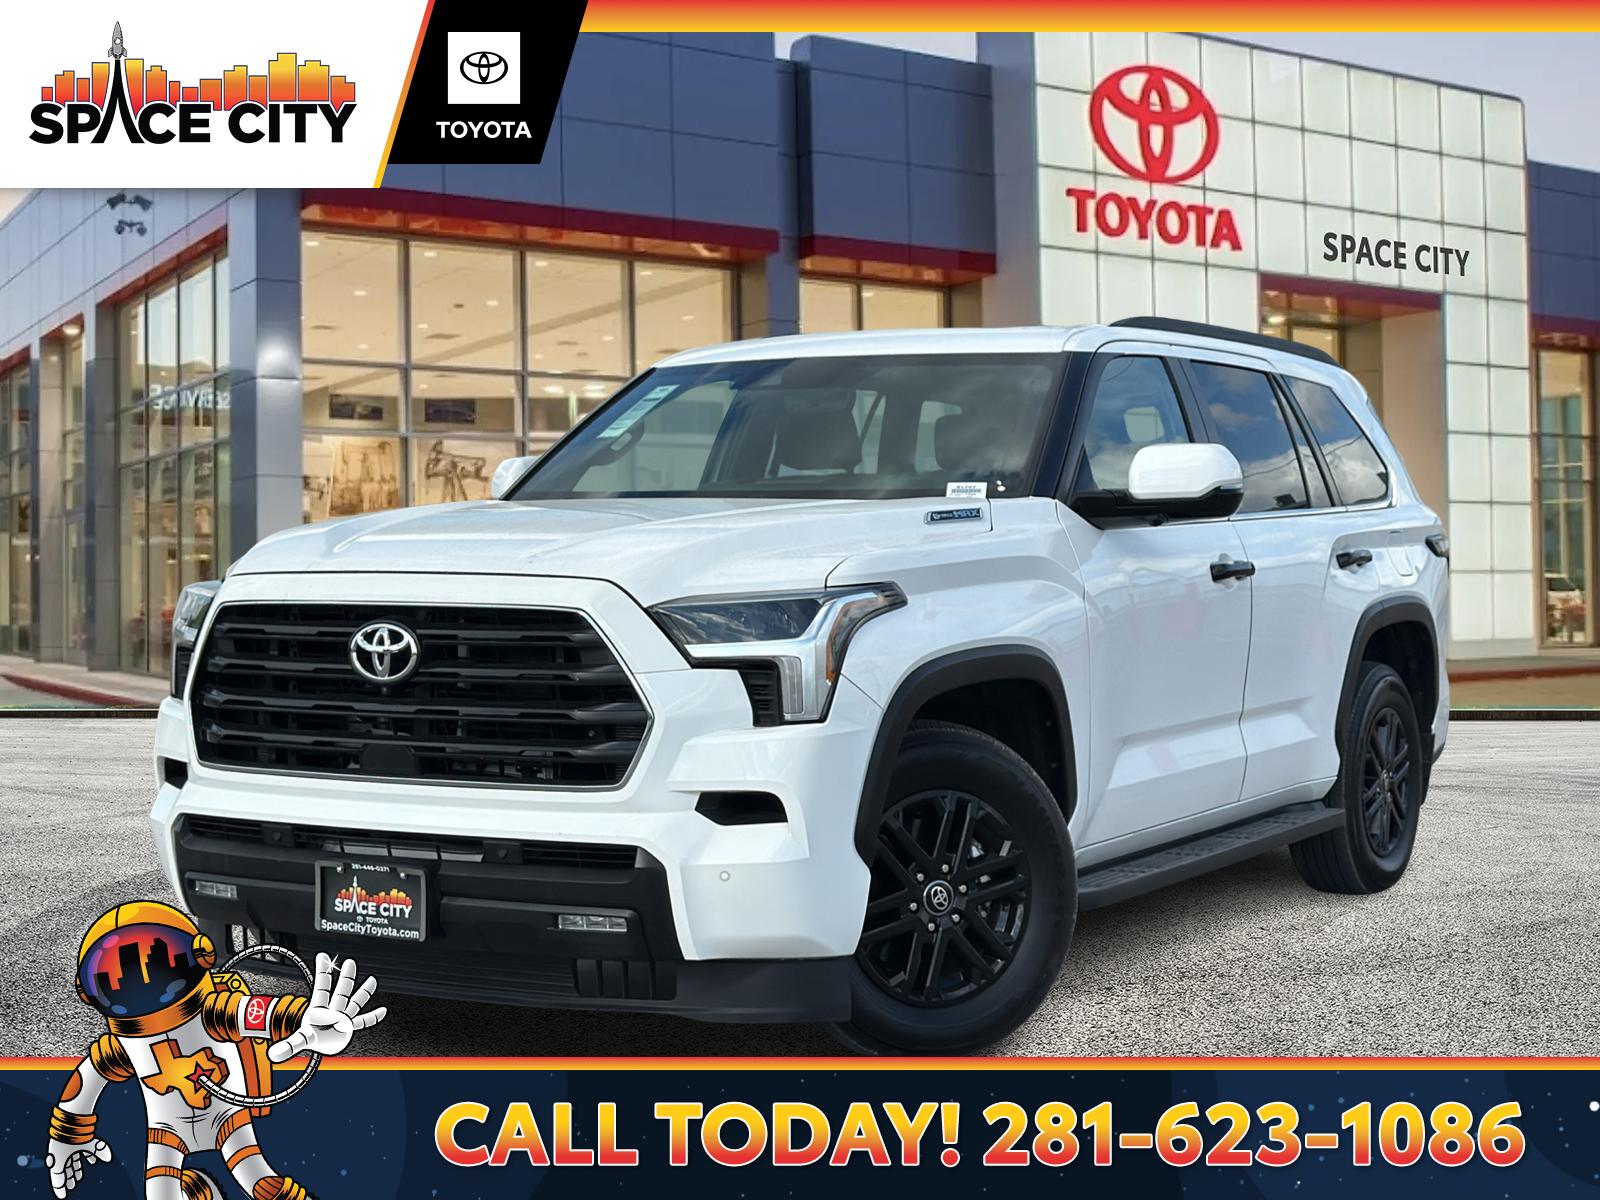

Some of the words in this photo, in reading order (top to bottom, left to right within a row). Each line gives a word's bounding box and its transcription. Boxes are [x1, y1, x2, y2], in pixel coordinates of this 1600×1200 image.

[1066, 187, 1242, 251] TOYOTA
[1323, 232, 1407, 270] SPACE
[1415, 244, 1470, 277] CITY
[334, 898, 376, 914] SPACE
[379, 903, 412, 918] CITY
[321, 919, 419, 938] SpaceCityToyota.com
[366, 916, 388, 924] TOYOTA
